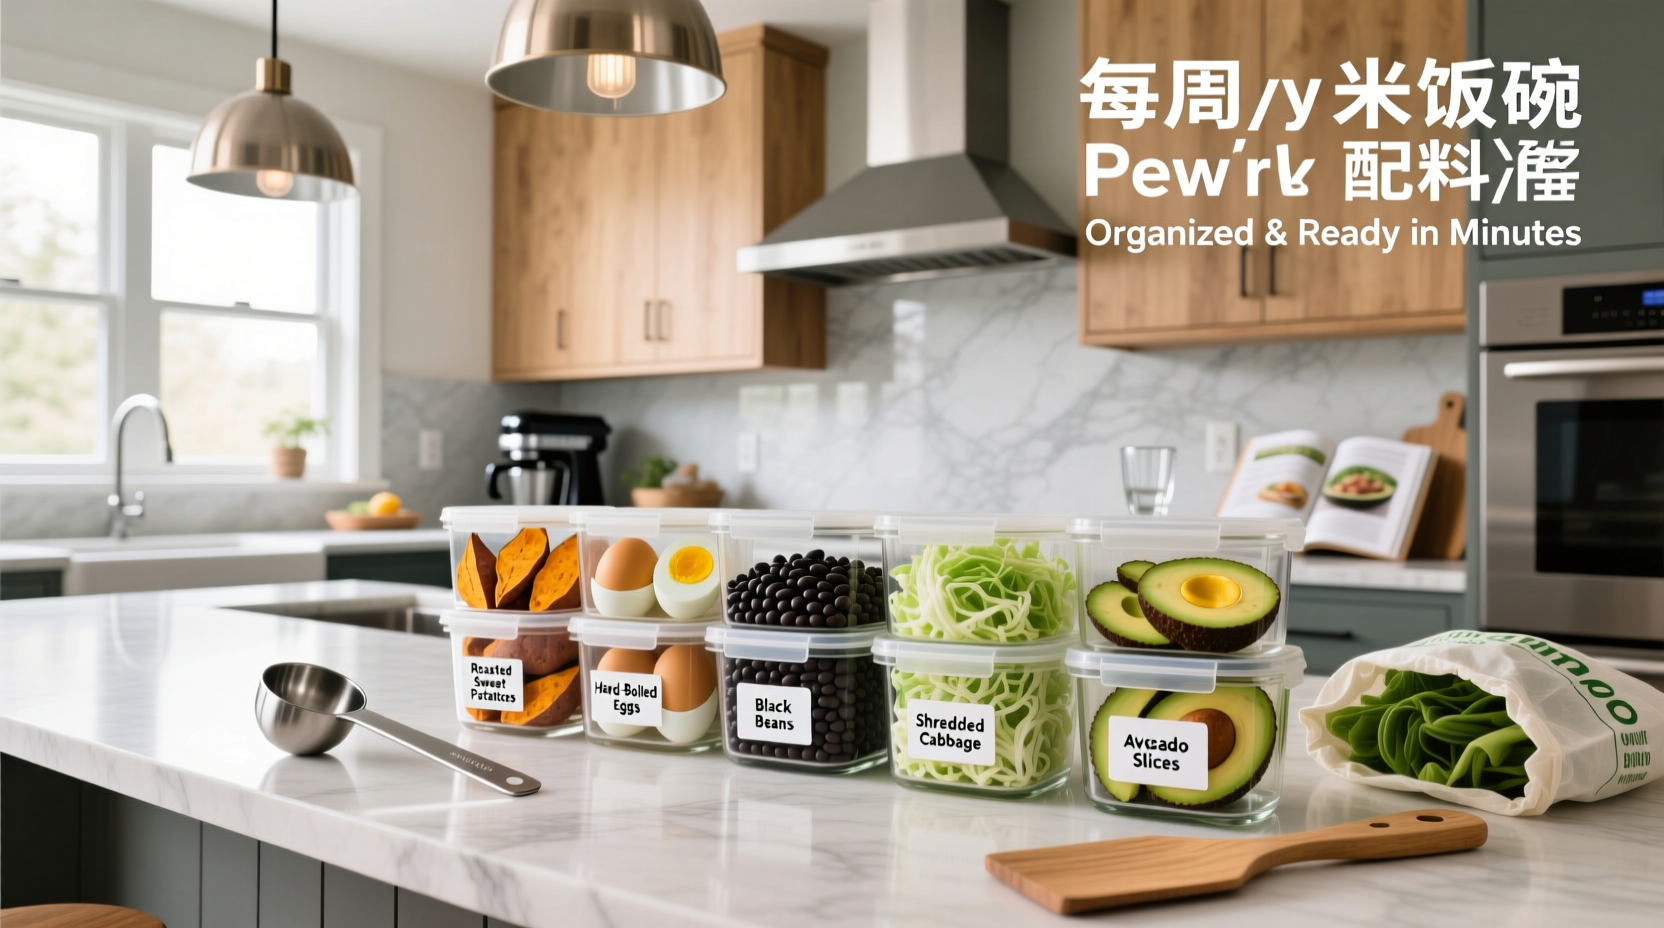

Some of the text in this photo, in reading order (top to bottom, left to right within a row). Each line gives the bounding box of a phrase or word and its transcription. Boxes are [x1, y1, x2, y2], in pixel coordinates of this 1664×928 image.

[613, 699, 641, 716] Eggs
[755, 697, 792, 714] Black
[755, 714, 795, 731] Beans
[916, 712, 985, 733] Shredded
[919, 731, 982, 753] Cabbage
[1133, 752, 1180, 771] Slices
